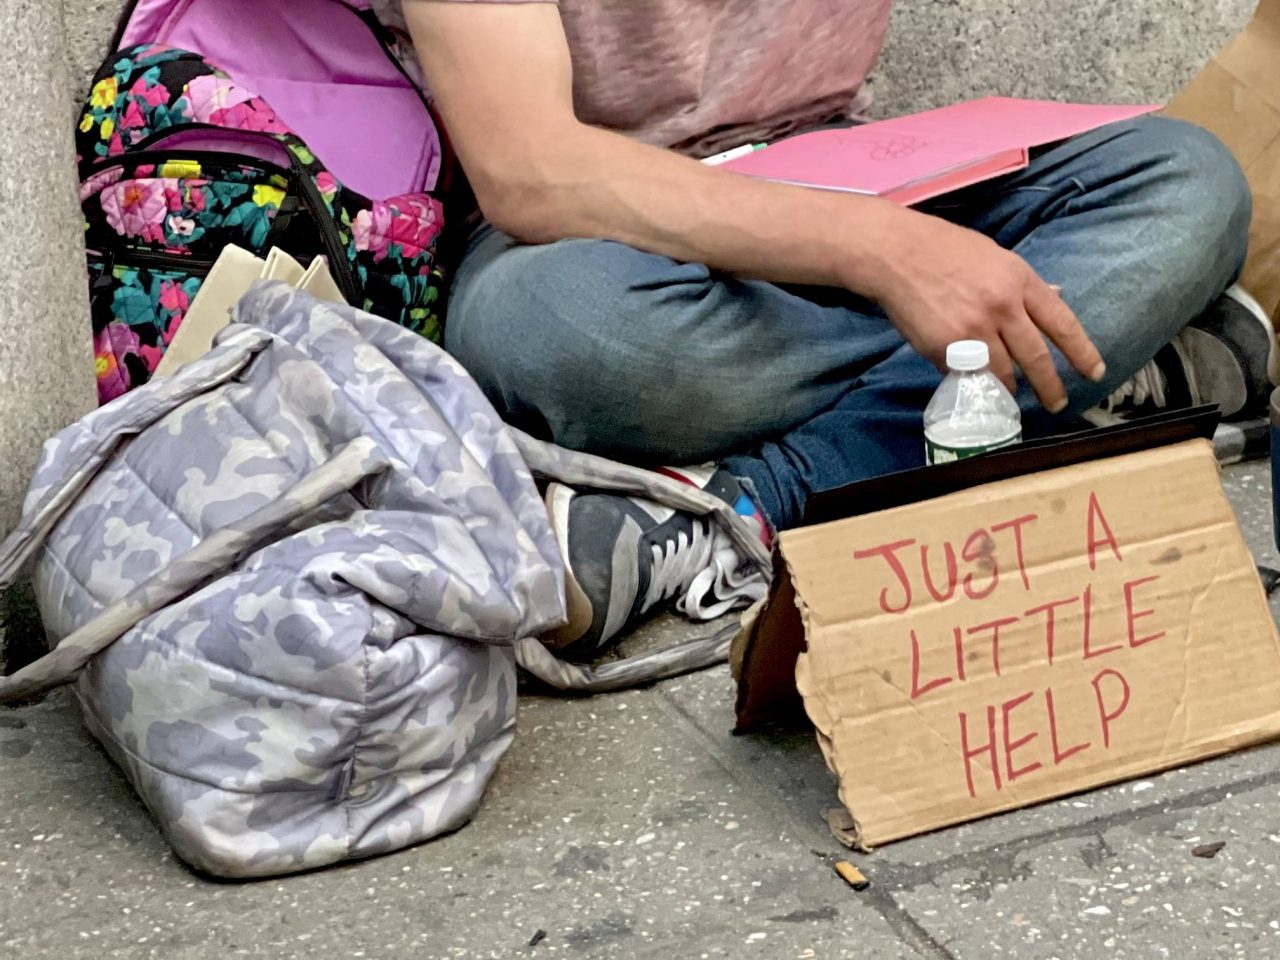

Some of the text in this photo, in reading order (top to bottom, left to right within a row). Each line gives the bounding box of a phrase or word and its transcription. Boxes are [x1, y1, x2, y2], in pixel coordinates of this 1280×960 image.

[853, 490, 1123, 614] JUST A
[909, 575, 1166, 700] LITTLE
[958, 668, 1131, 798] HELP
